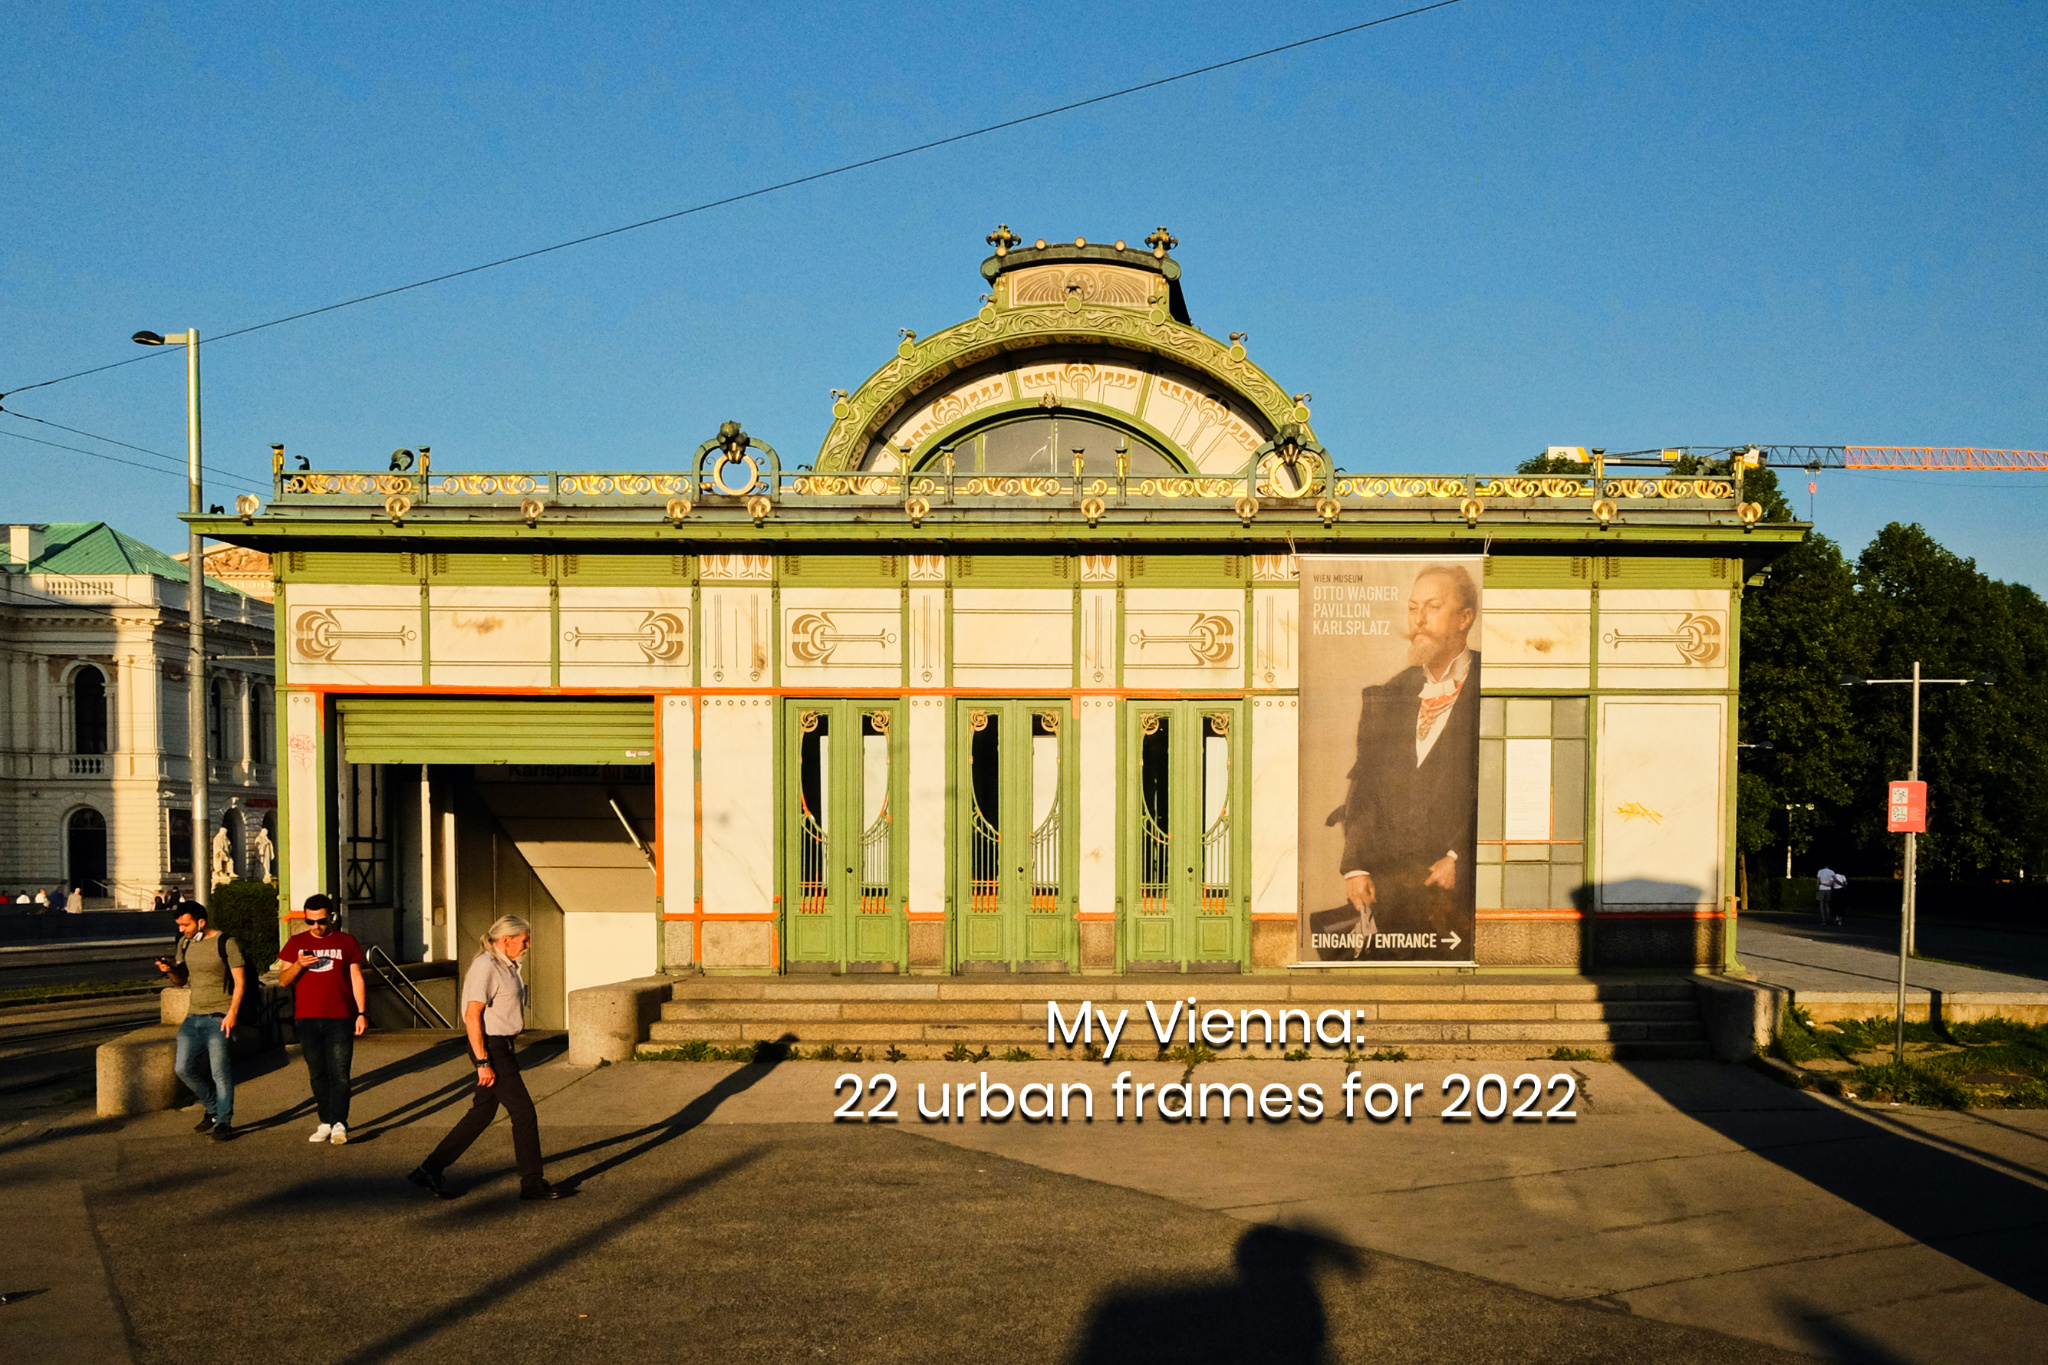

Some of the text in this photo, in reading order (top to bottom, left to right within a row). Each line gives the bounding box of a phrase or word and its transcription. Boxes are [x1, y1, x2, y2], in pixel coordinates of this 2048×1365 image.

[1313, 574, 1363, 583] WIEN MUSEUM
[1313, 586, 1399, 601] OTTO WAGNER
[1313, 603, 1370, 618] PAVILLON
[1313, 620, 1390, 636] KARLSPLATZ
[1311, 933, 1363, 949] EINGANG
[1375, 933, 1437, 949] ENTRANCE
[298, 949, 343, 960] NADA
